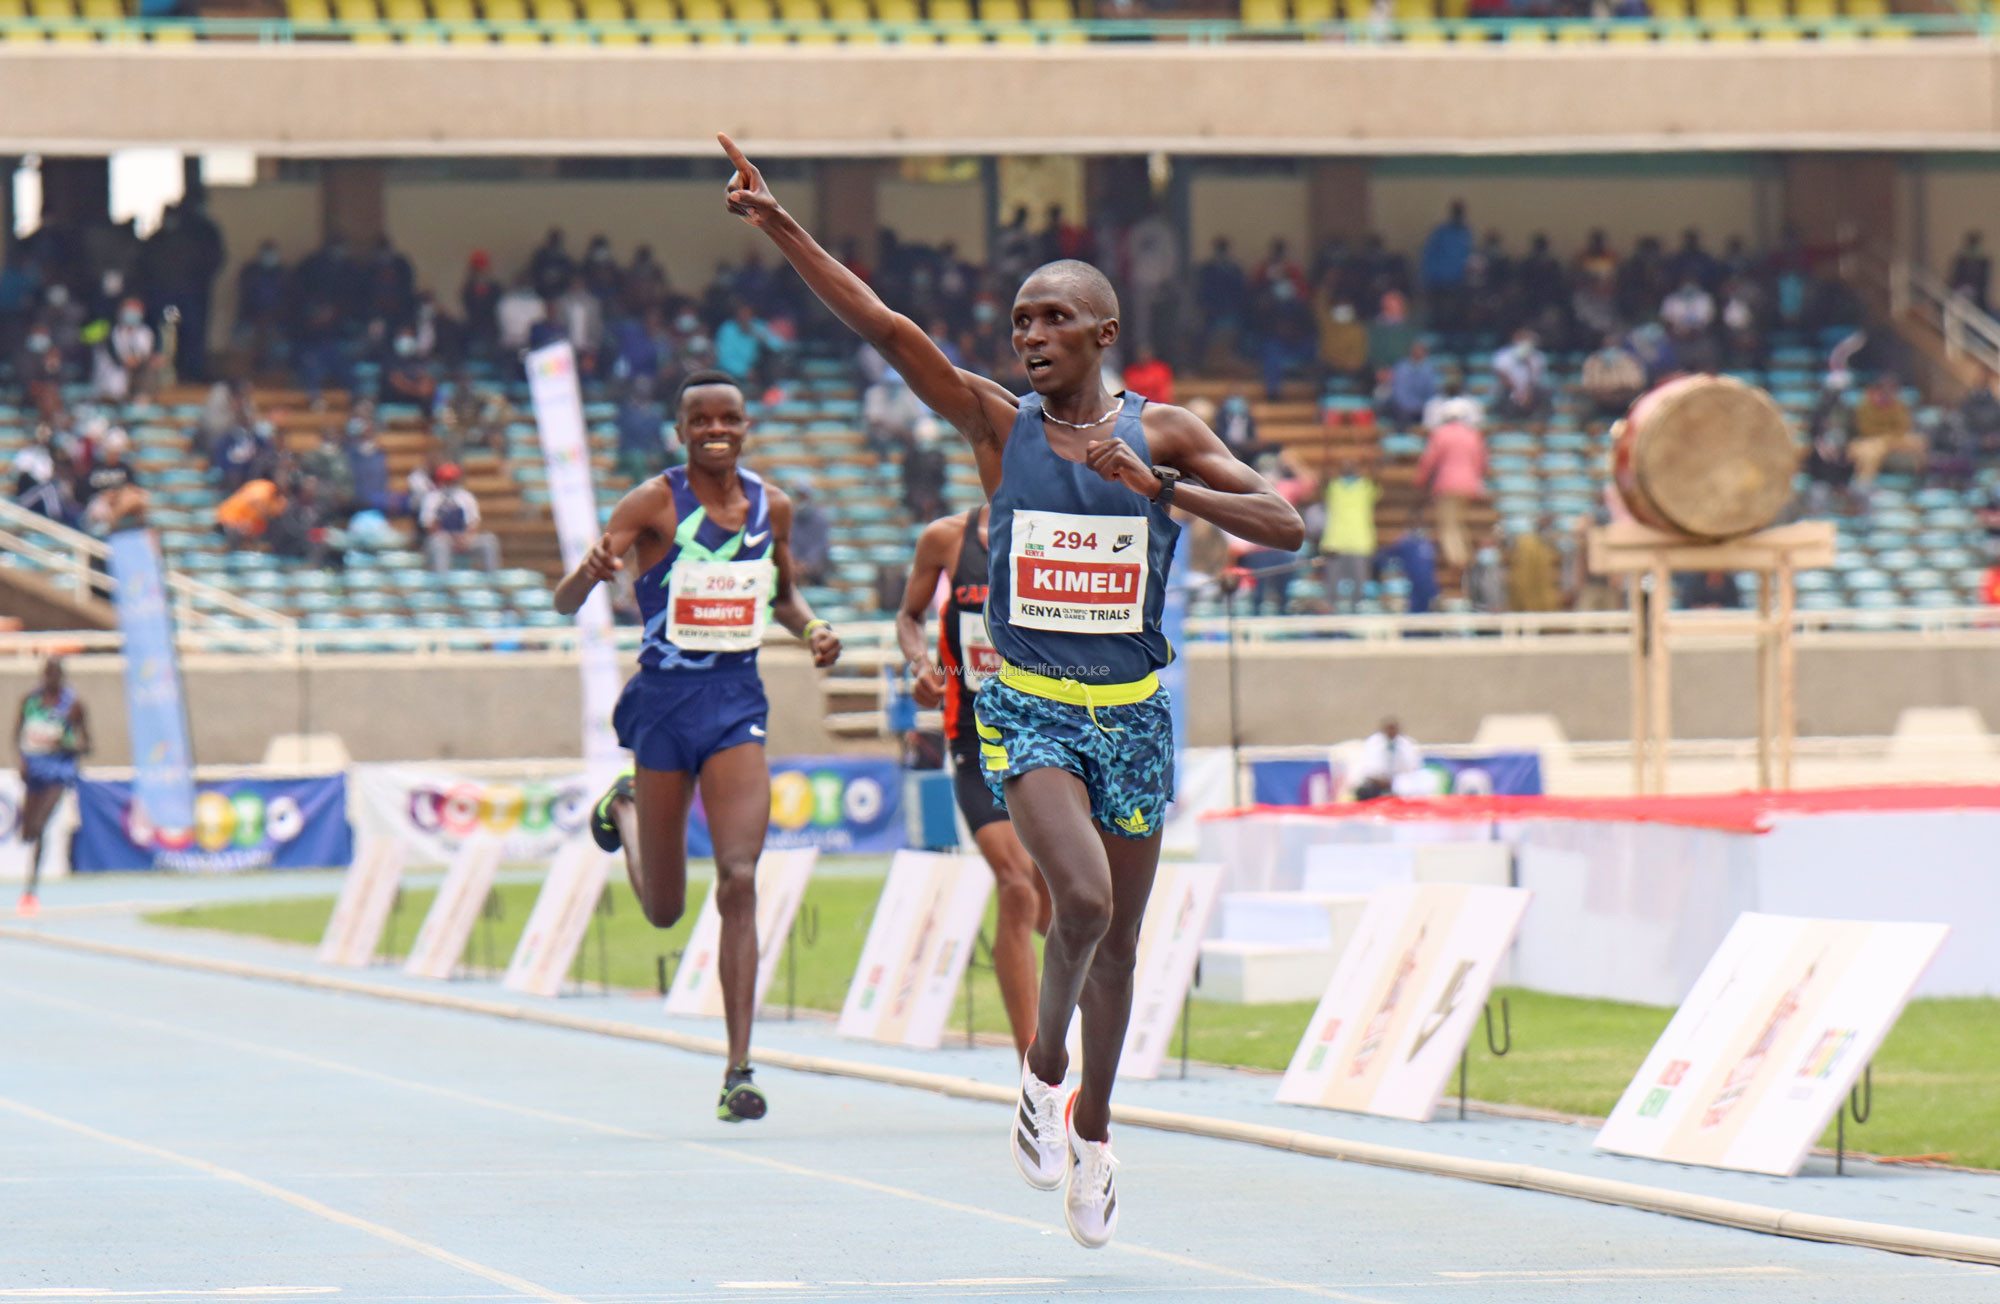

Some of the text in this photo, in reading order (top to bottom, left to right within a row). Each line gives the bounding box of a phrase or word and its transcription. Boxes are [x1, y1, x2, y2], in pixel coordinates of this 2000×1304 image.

[1052, 530, 1098, 550] 294
[1117, 534, 1134, 545] NIKE
[1033, 568, 1133, 593] KIMELI
[1021, 604, 1062, 618] KENYA
[1089, 609, 1131, 621] TRIALS
